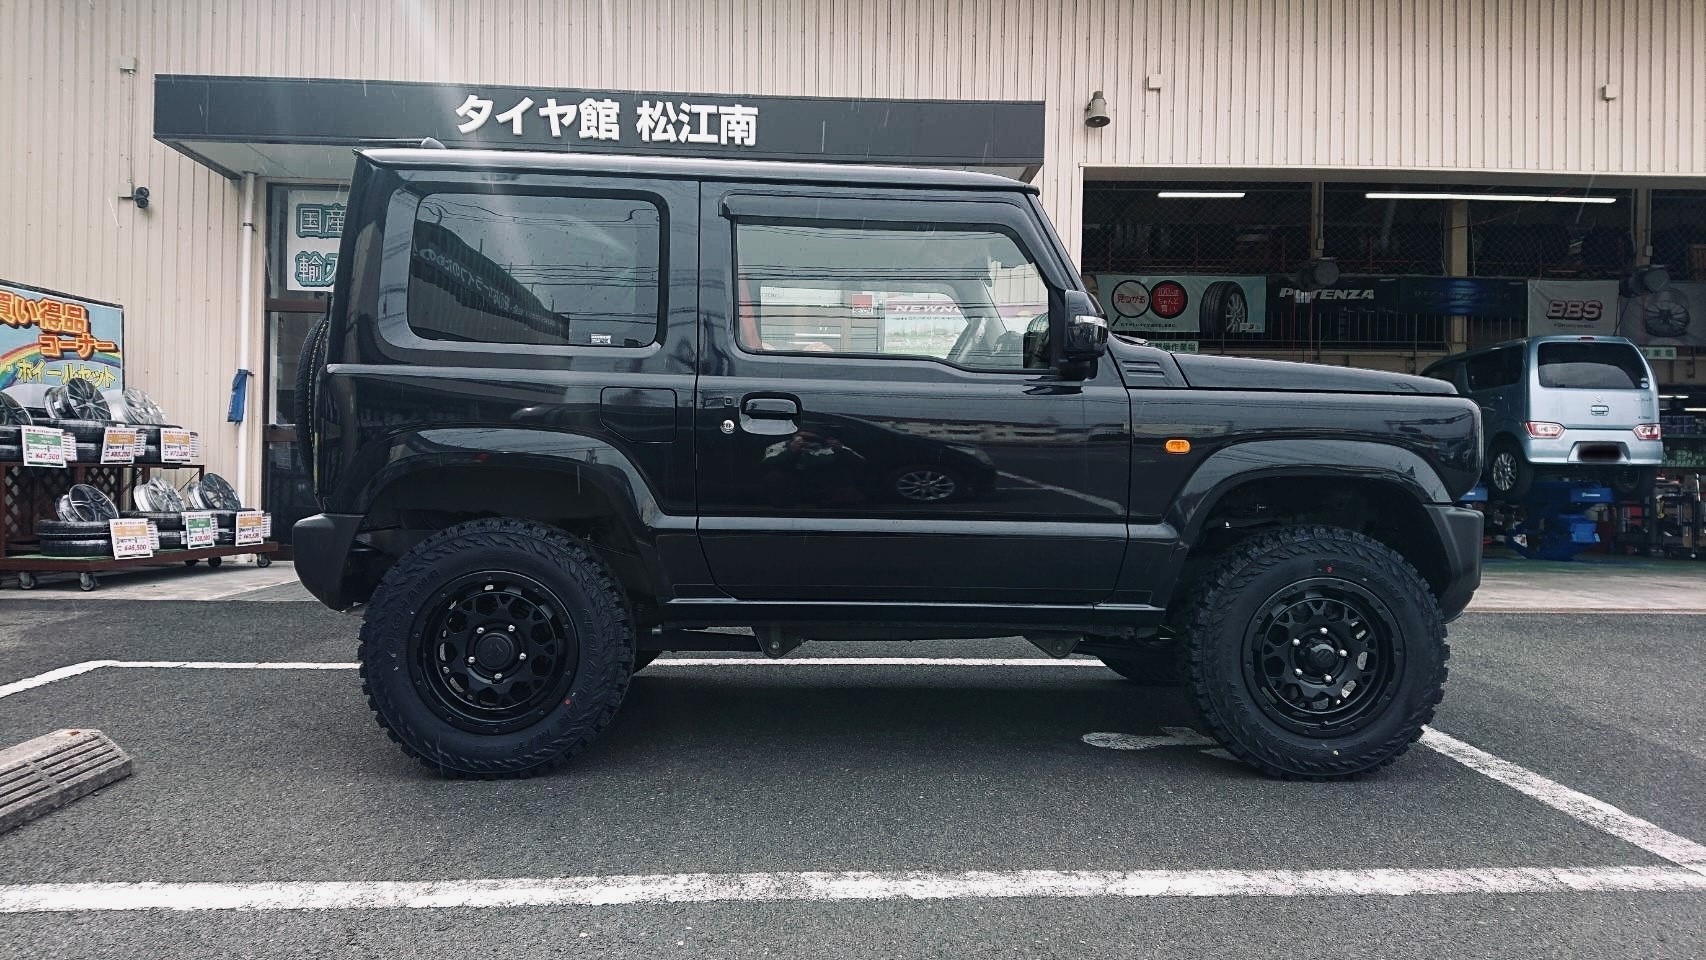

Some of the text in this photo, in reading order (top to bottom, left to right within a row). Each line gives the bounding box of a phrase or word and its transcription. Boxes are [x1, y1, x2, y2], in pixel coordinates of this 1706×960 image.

[455, 94, 759, 147] タイヤ館 松江南
[1280, 287, 1375, 300] PTENZA
[1546, 299, 1603, 321] BBS
[38, 334, 117, 361] コーナー
